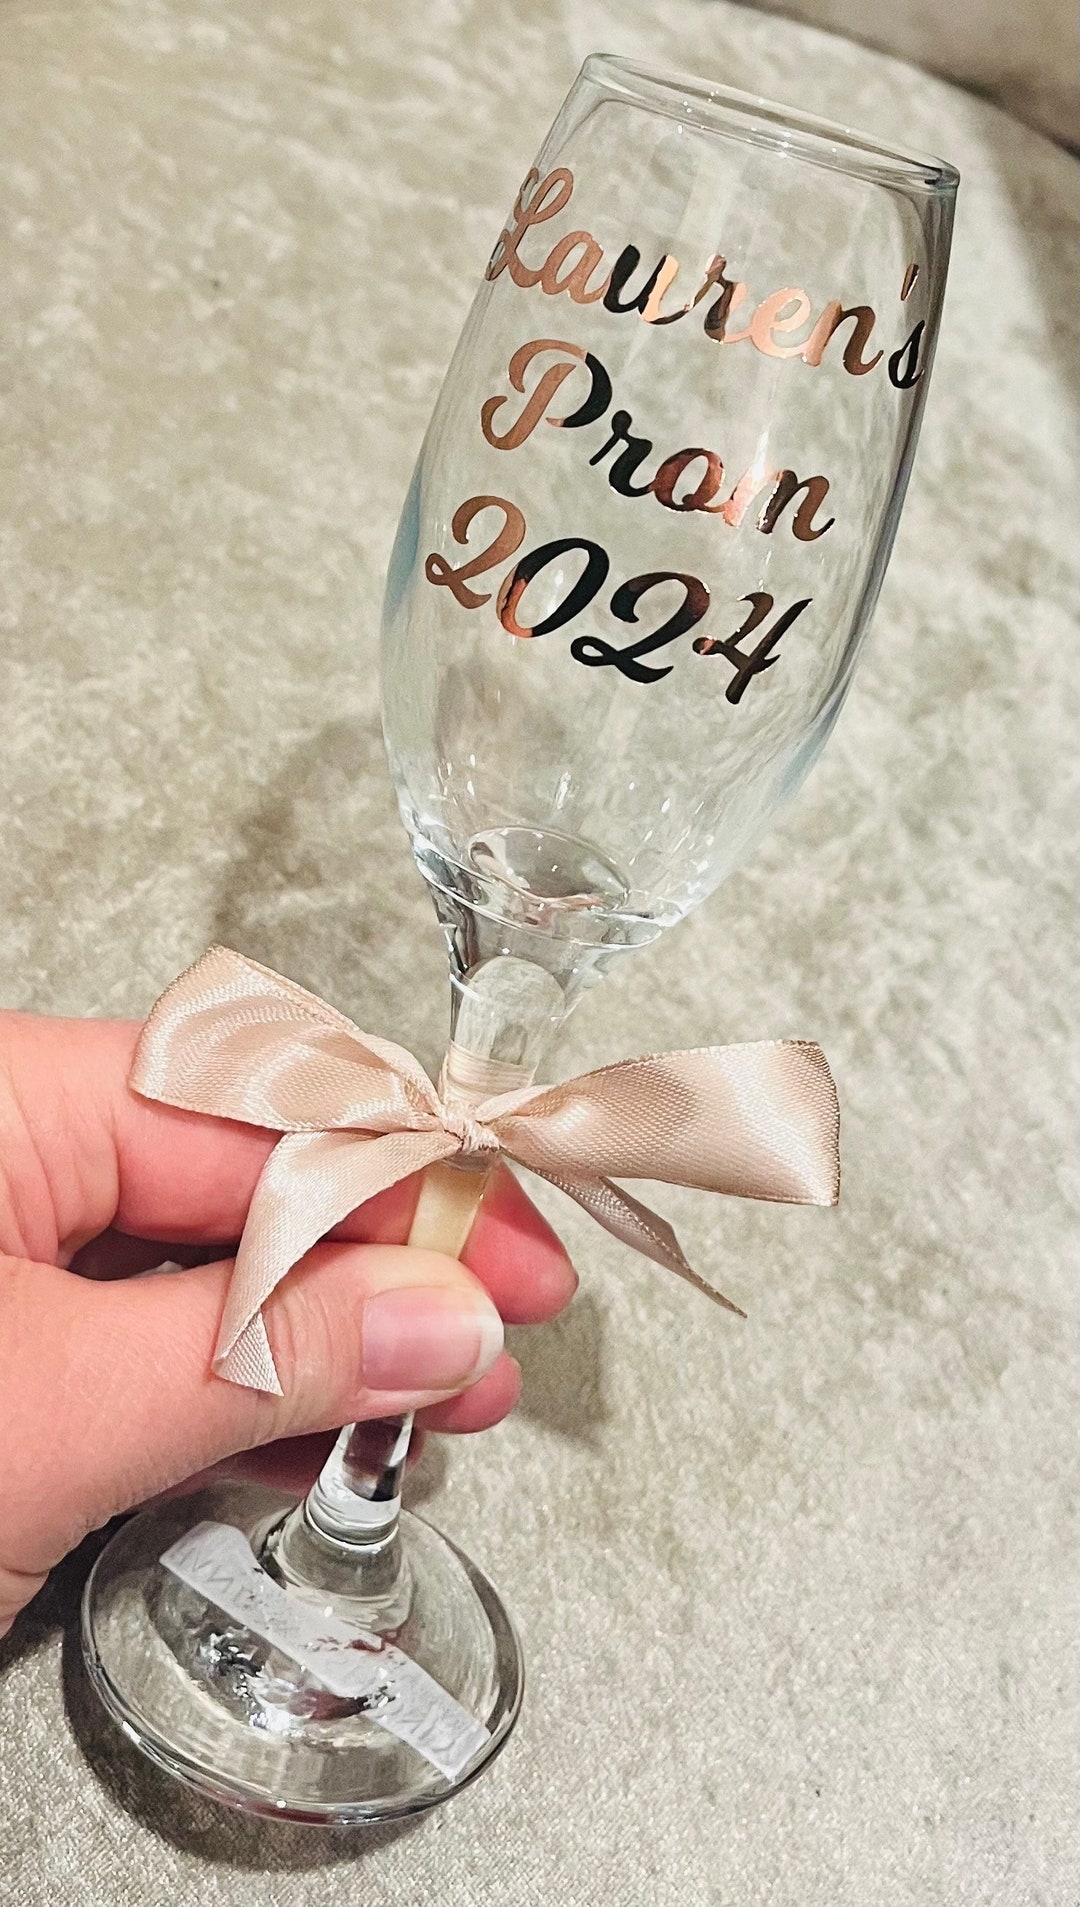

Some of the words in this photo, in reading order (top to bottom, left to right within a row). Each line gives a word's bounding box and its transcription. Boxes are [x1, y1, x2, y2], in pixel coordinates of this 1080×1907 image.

[486, 167, 924, 389] Lauren's
[481, 339, 835, 541] Prom
[425, 495, 814, 704] 2024
